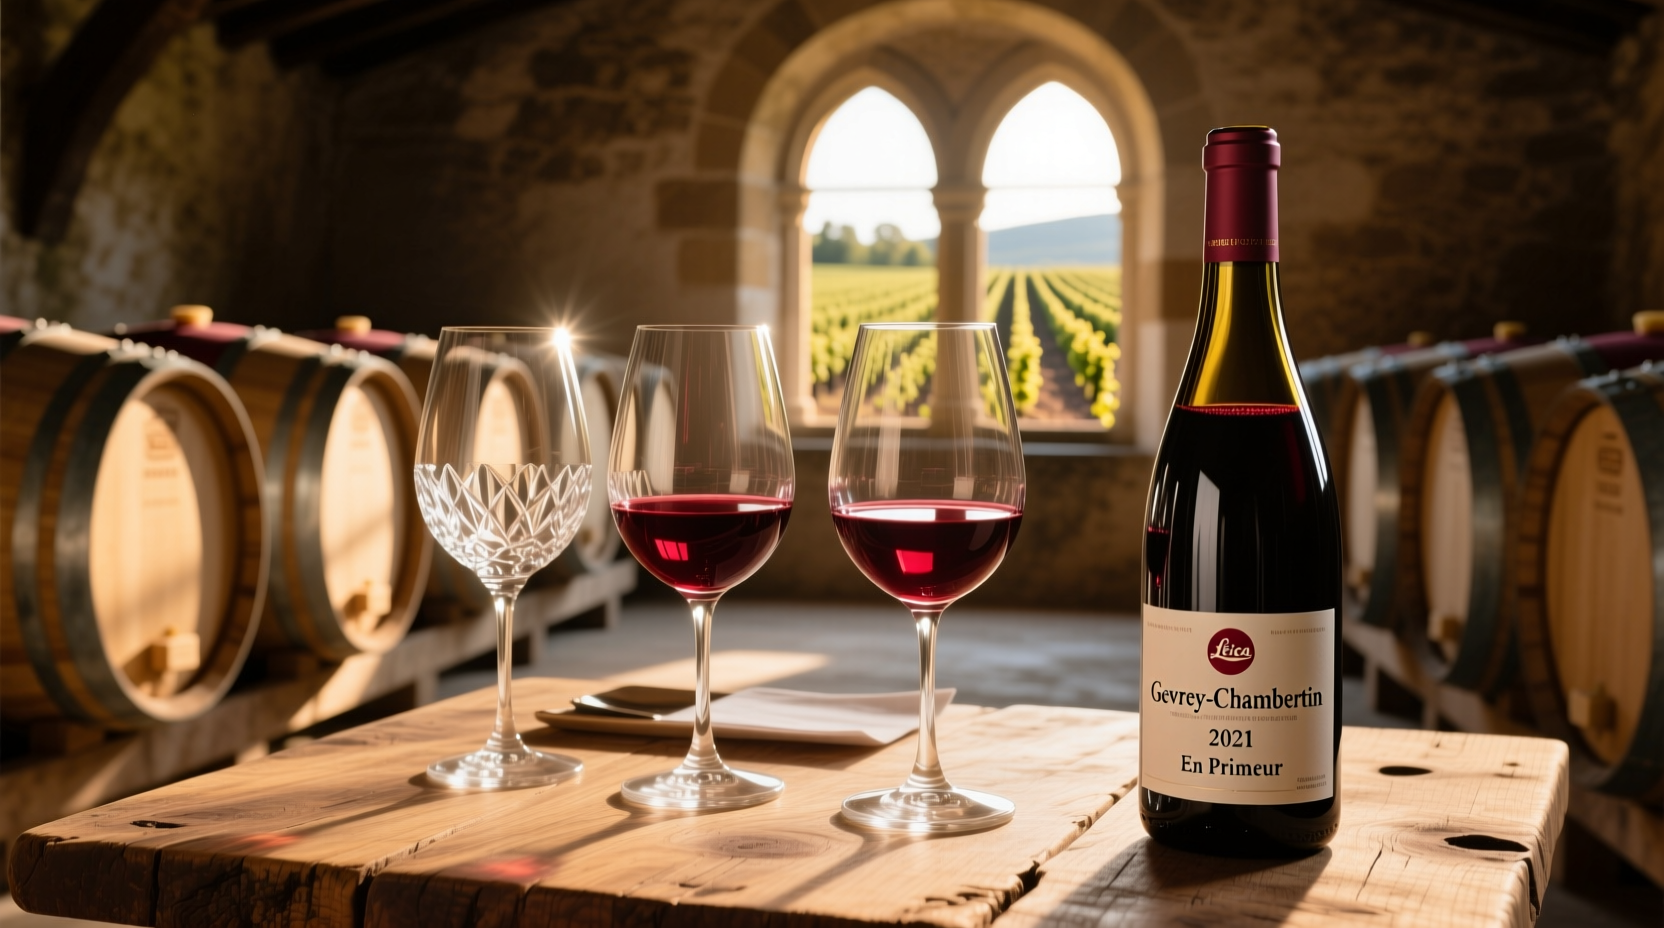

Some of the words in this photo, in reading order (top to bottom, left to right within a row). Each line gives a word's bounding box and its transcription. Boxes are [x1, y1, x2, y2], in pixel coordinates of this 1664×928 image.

[1151, 680, 1323, 713] Gevrey-Chambertin
[1208, 728, 1253, 748] 2021
[1181, 754, 1203, 774] En
[1208, 757, 1283, 776] Primeur
